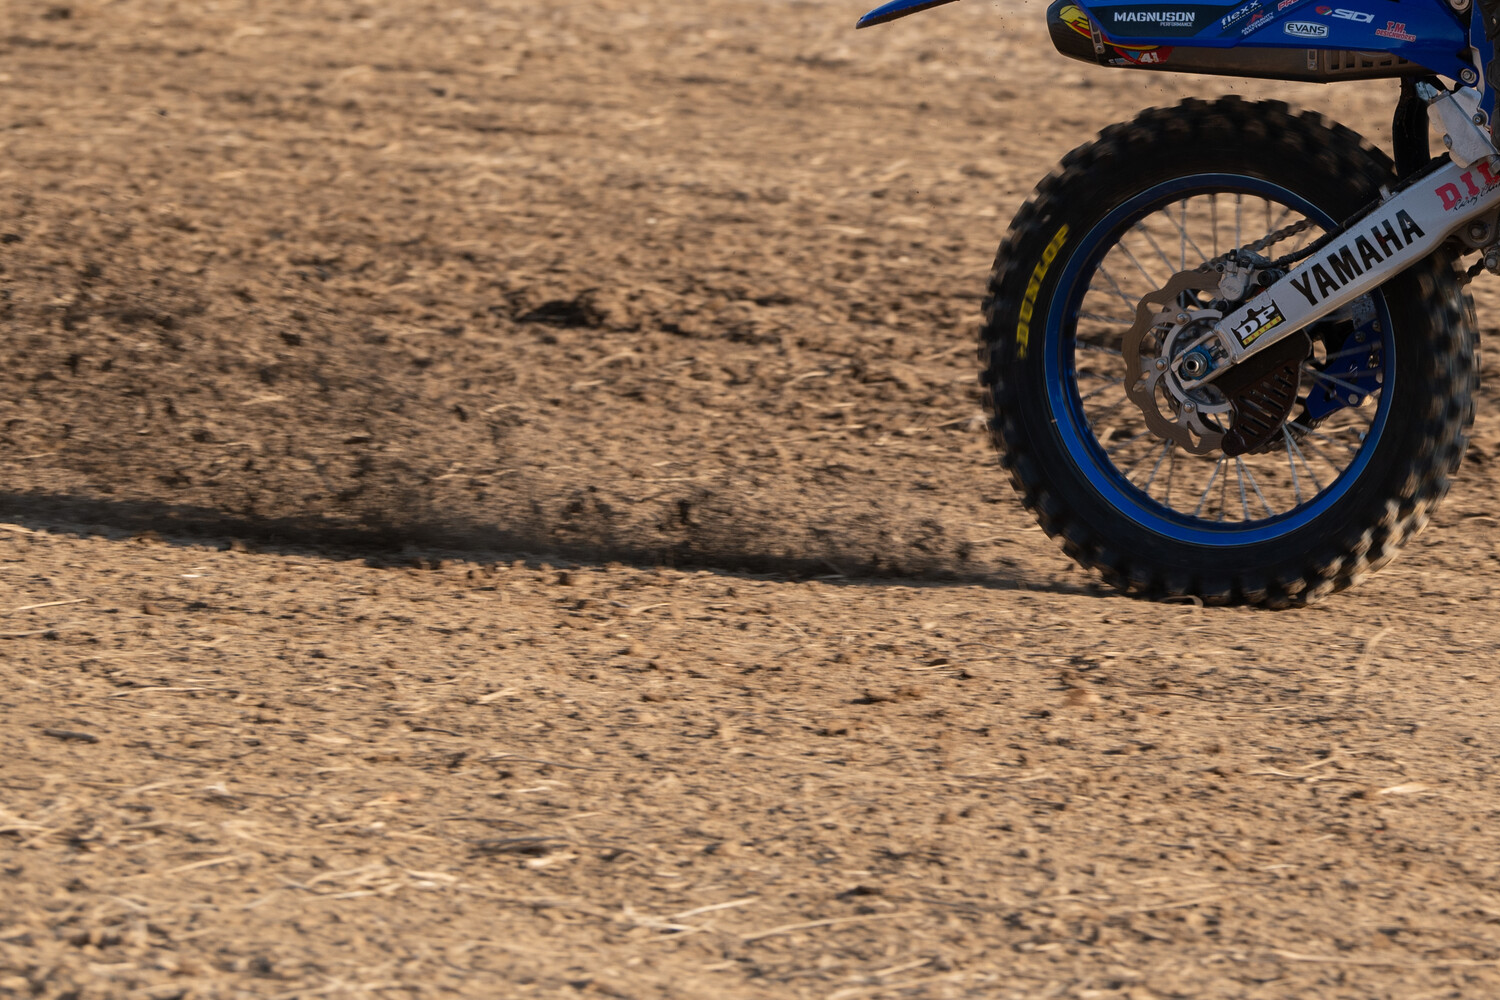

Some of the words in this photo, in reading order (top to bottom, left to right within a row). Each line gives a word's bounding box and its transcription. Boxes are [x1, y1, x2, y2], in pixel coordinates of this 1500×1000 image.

[1113, 11, 1196, 22] MAGNUSON
[1331, 8, 1376, 24] SIDI
[1287, 23, 1326, 35] EVANS
[1386, 21, 1407, 33] T.M.
[1375, 29, 1417, 42] DESIGNWORKS
[1290, 208, 1426, 306] YAMAHA
[1236, 305, 1276, 340] DP
